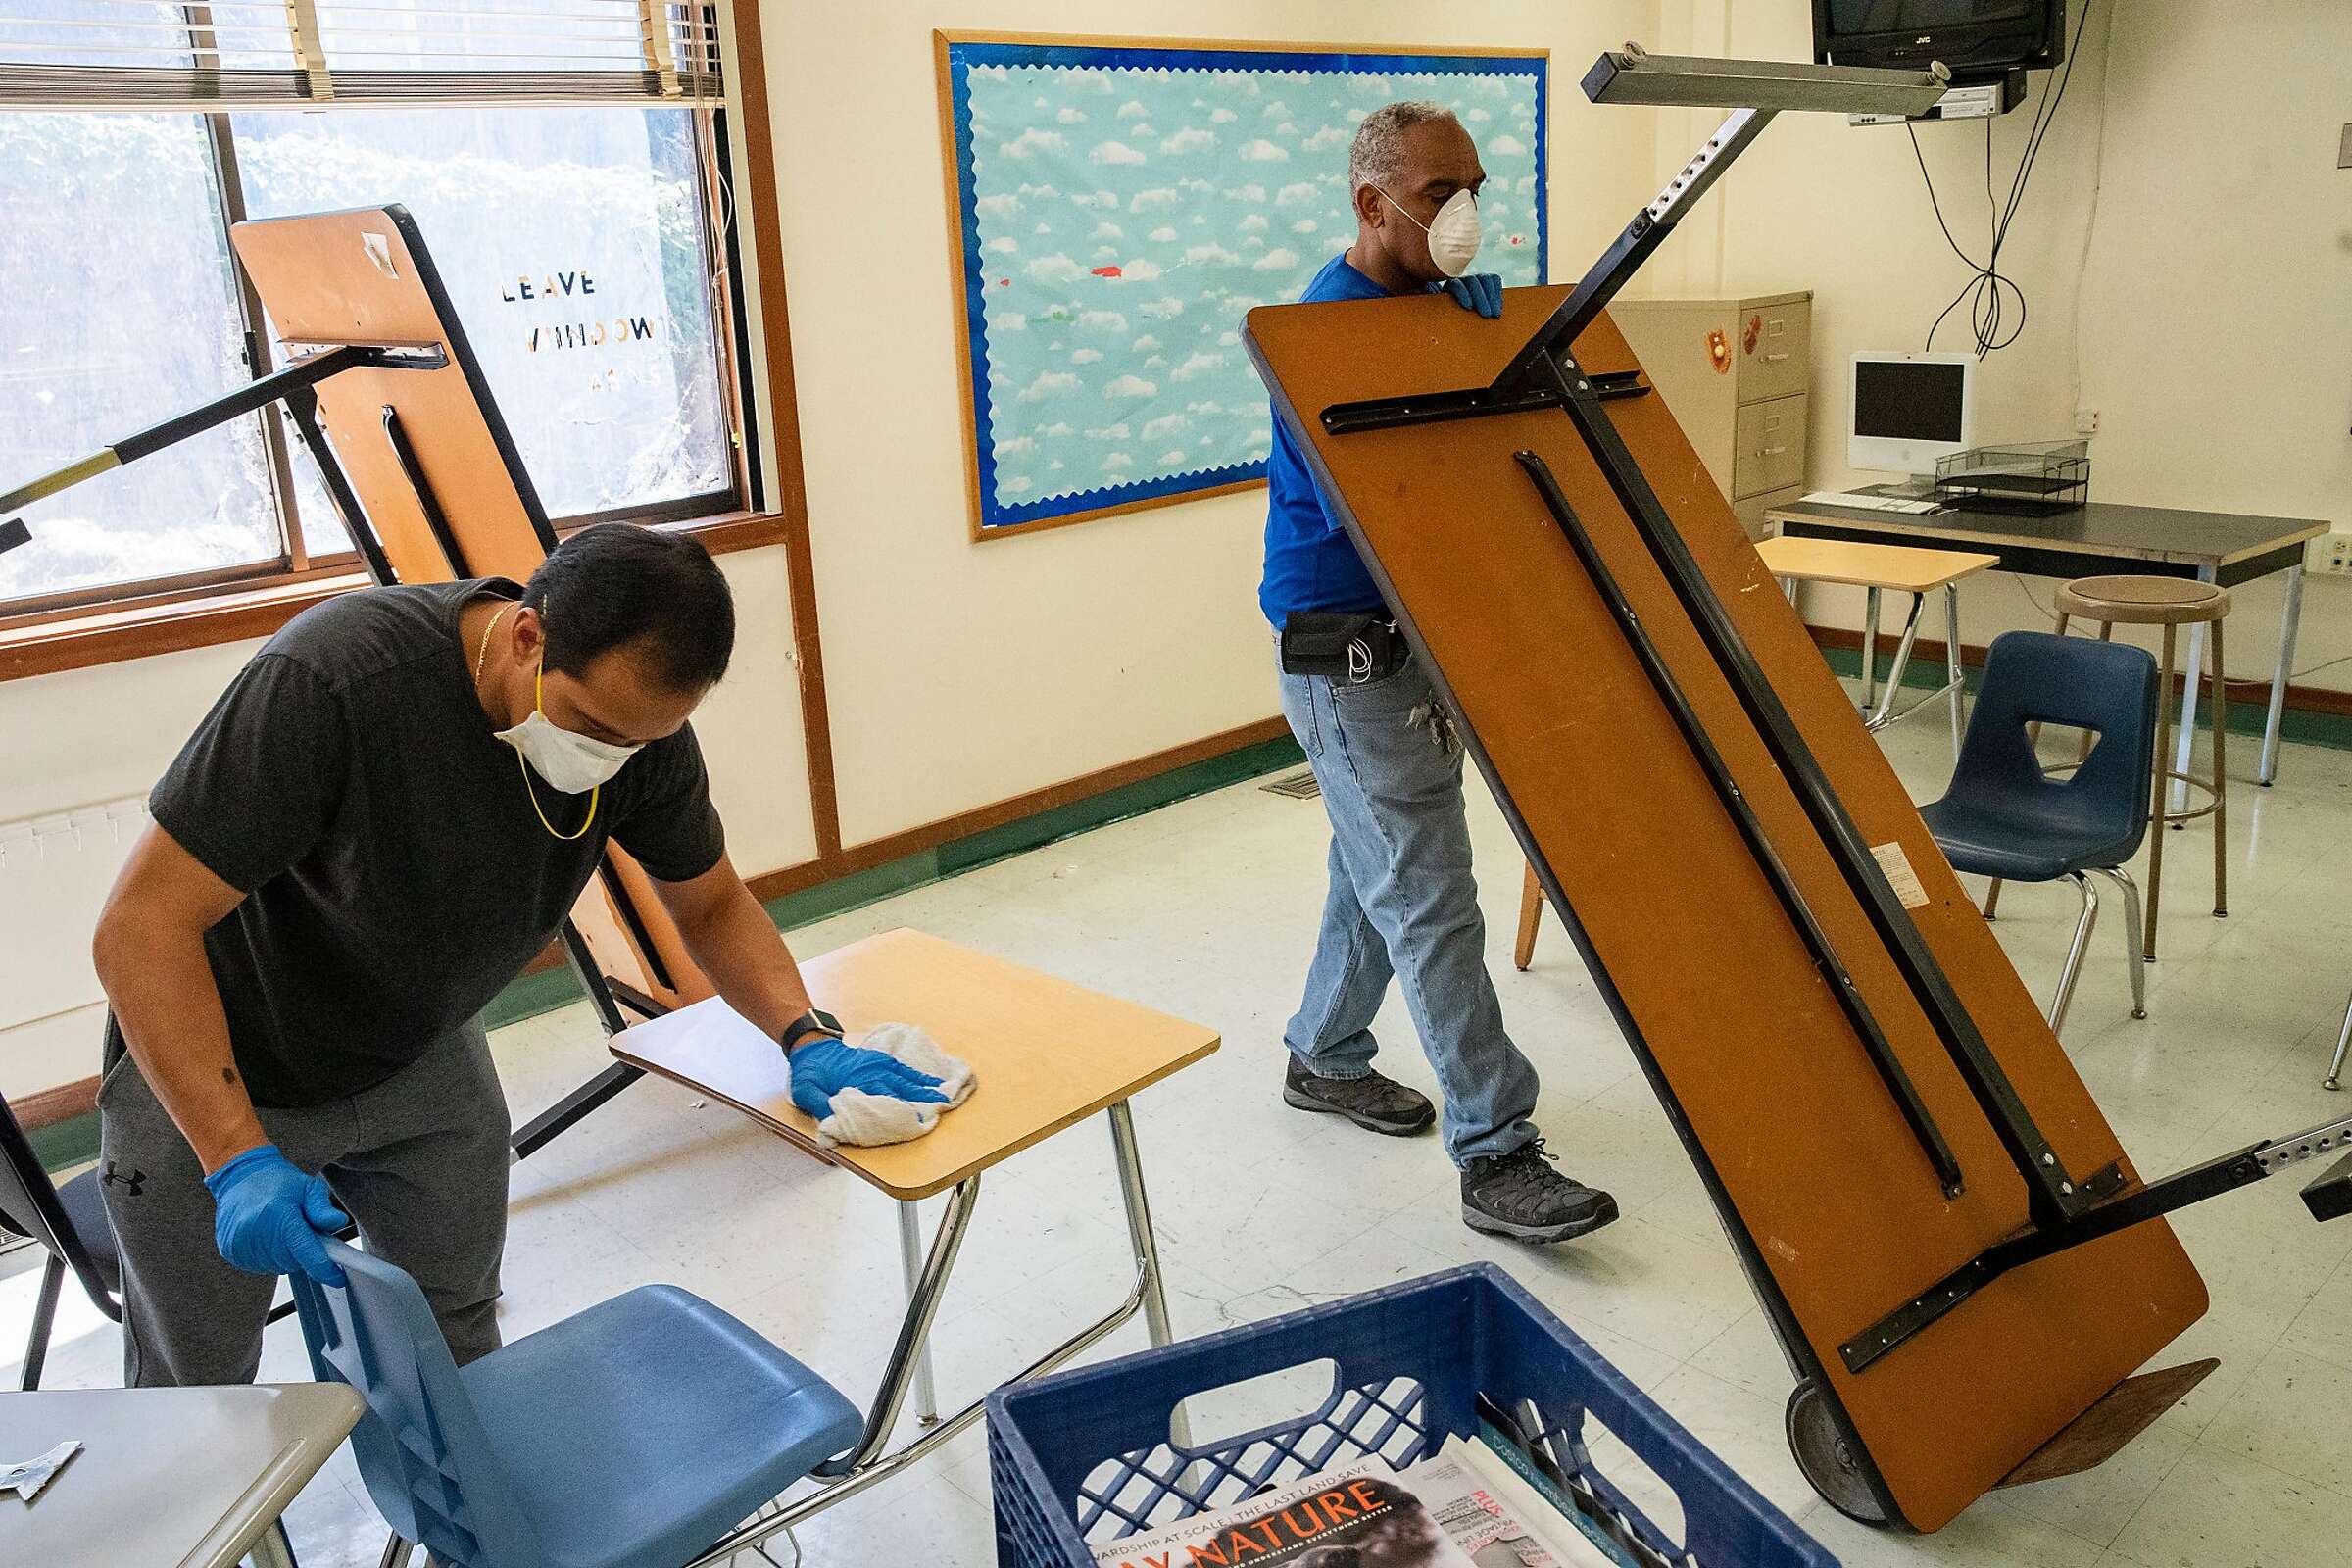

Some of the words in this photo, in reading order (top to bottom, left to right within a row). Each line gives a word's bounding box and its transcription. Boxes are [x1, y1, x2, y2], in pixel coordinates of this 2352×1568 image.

[502, 270, 595, 302] LEAVE
[1164, 1533, 1180, 1544] AT
[1186, 1518, 1224, 1539] SCALE
[1236, 1504, 1261, 1521] THE
[1265, 1492, 1295, 1511] LAST
[1300, 1477, 1336, 1496] LAND
[1339, 1464, 1369, 1482] SAVE
[1185, 1481, 1386, 1568] NATURE
[1248, 1540, 1305, 1565] UNDERSTAND
[1306, 1518, 1359, 1544] EVERYTHING
[1361, 1504, 1393, 1521] BETTER
[1471, 1490, 1503, 1519] PLUS
